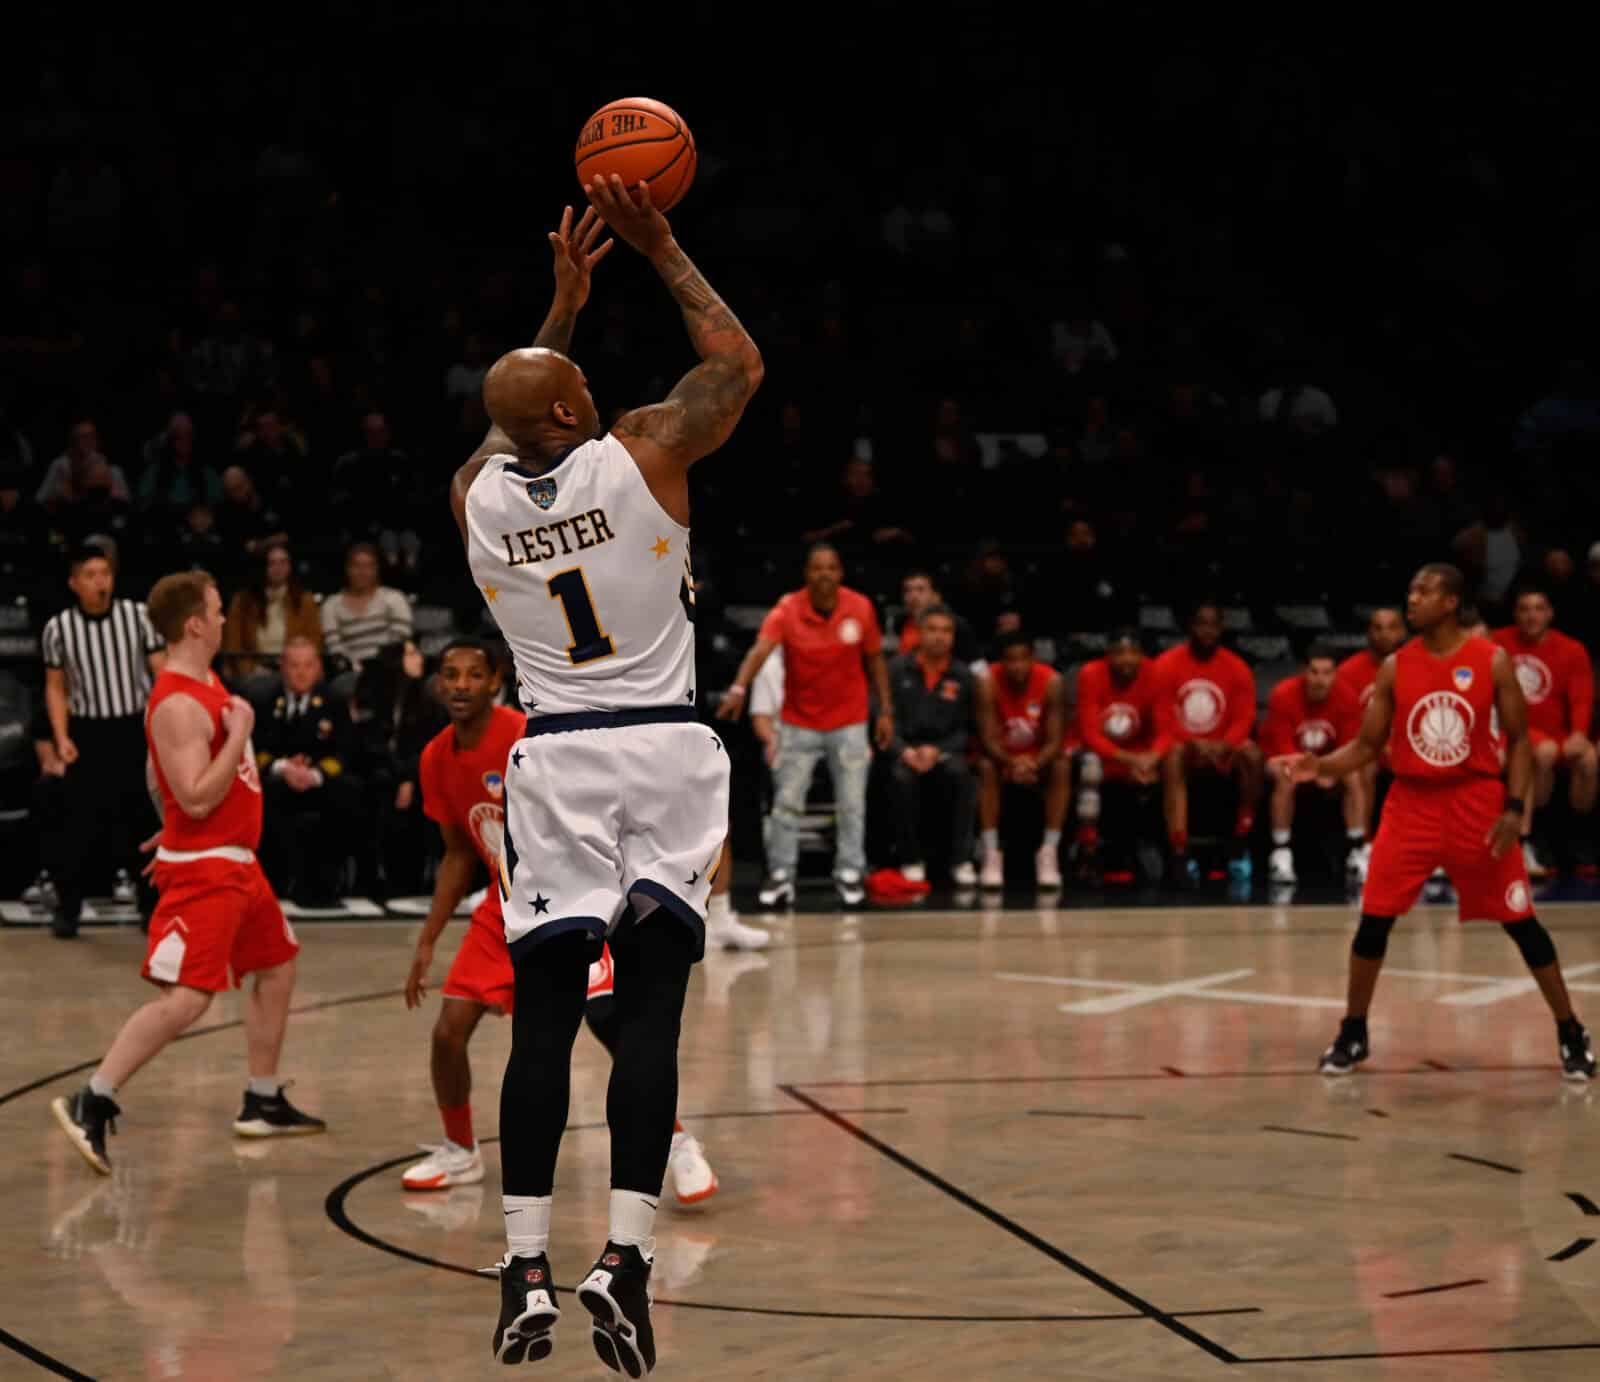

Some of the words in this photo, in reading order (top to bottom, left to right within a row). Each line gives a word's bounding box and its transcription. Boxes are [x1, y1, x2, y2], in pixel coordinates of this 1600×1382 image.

[611, 114, 648, 136] THE
[502, 508, 615, 566] LESTER
[547, 566, 615, 665] 1
